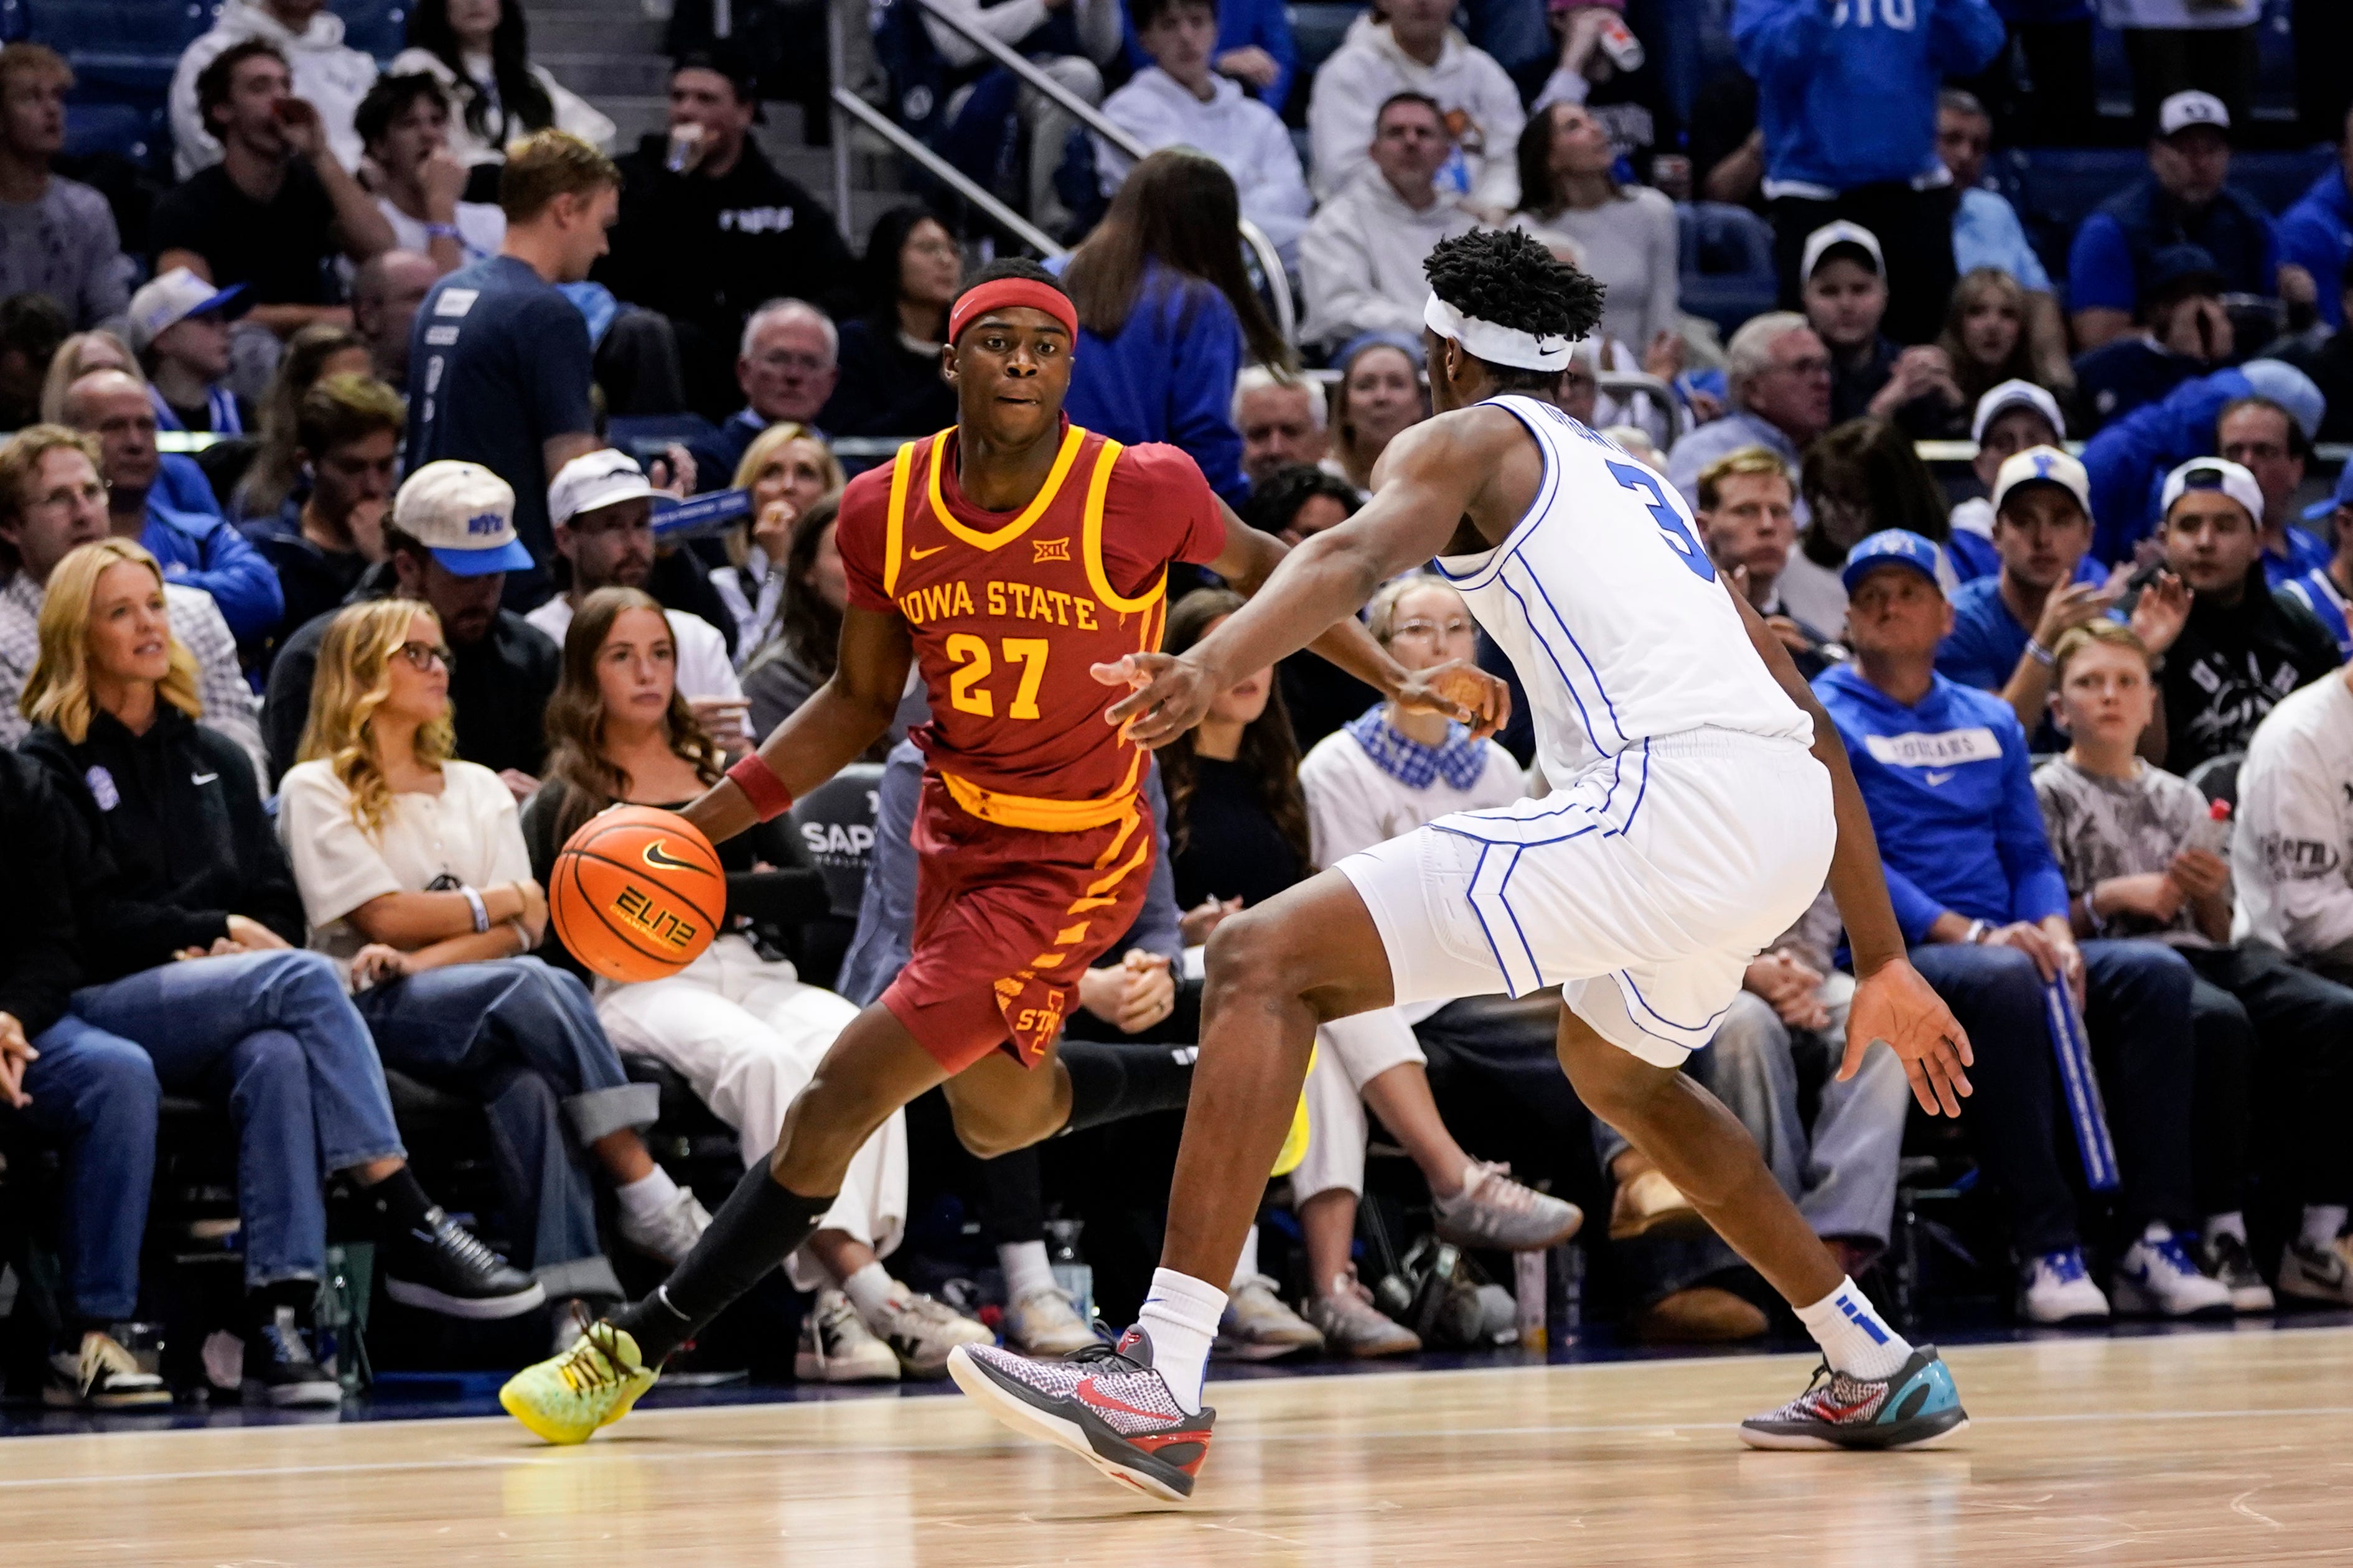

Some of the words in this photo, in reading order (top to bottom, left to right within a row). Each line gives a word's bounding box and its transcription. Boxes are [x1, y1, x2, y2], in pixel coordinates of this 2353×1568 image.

[1604, 457, 1715, 584] 3
[898, 581, 975, 625] IOWA
[987, 581, 1098, 631] STATE
[945, 633, 1049, 719] 27
[616, 885, 697, 947] ELITE
